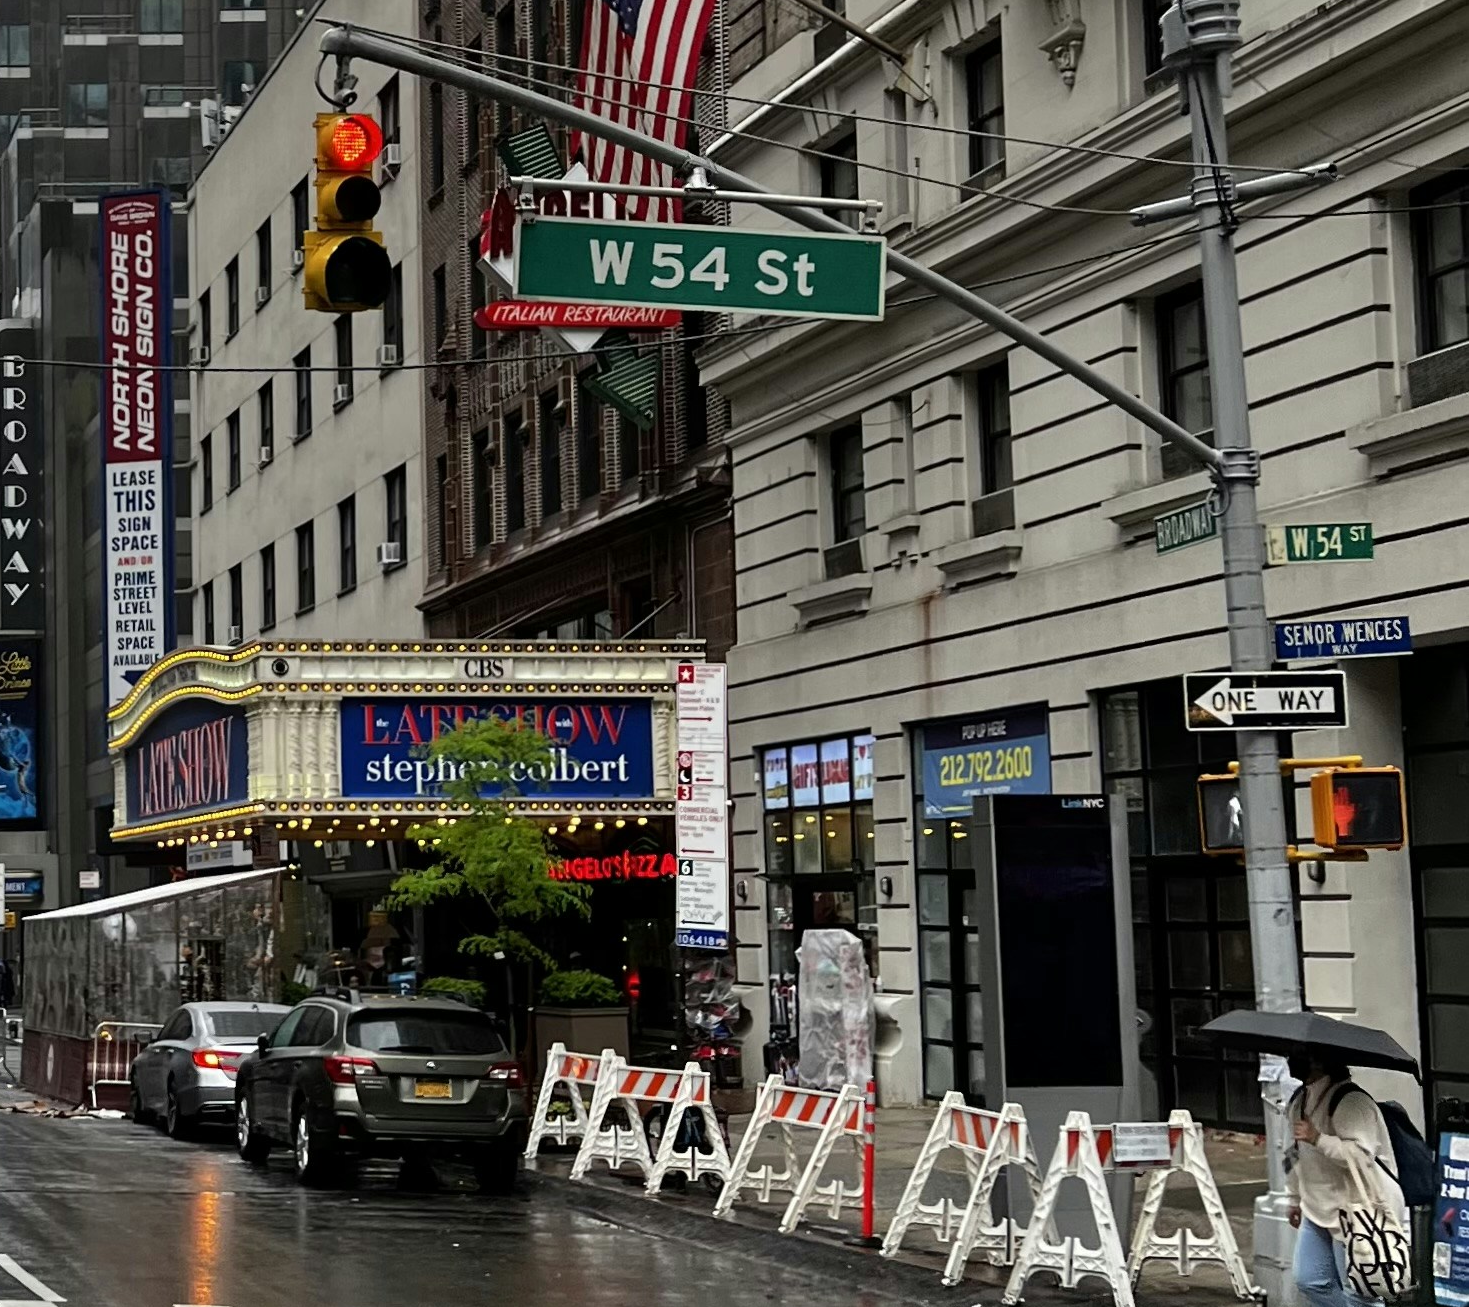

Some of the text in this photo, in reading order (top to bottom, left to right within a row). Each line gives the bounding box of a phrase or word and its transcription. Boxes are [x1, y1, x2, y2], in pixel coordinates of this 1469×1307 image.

[589, 239, 816, 296] W 54 St
[493, 305, 666, 322] ITALIAN RESTAURANT
[111, 231, 131, 451] NORTH SHORE
[135, 230, 155, 453] NEON SIGN CO.
[2, 355, 31, 605] BROADWAY
[113, 470, 156, 487] LEASE
[114, 489, 156, 513] THIS
[118, 516, 151, 532] SIGN
[111, 535, 159, 552] SPACE
[1292, 526, 1366, 557] W 54 ST
[118, 555, 153, 566] AND/OR
[114, 571, 156, 586] PRIME
[113, 586, 157, 601] STREET
[118, 601, 152, 615] LEVEL
[116, 619, 156, 633] RETAIL
[1284, 620, 1403, 646] SENOR WENCES
[118, 636, 155, 651] SPACE
[1332, 644, 1358, 655] WAY
[113, 653, 160, 667] AVAILABLE
[464, 658, 504, 679] CBS
[1212, 690, 1324, 711] ONE WAY
[376, 718, 389, 728] the
[138, 716, 233, 818] LATE SHOW
[940, 745, 1032, 786] 212.792.2600
[681, 787, 690, 799] 3
[1062, 798, 1104, 808] LinkNYC
[681, 861, 690, 874] 6
[679, 935, 715, 946] 106418
